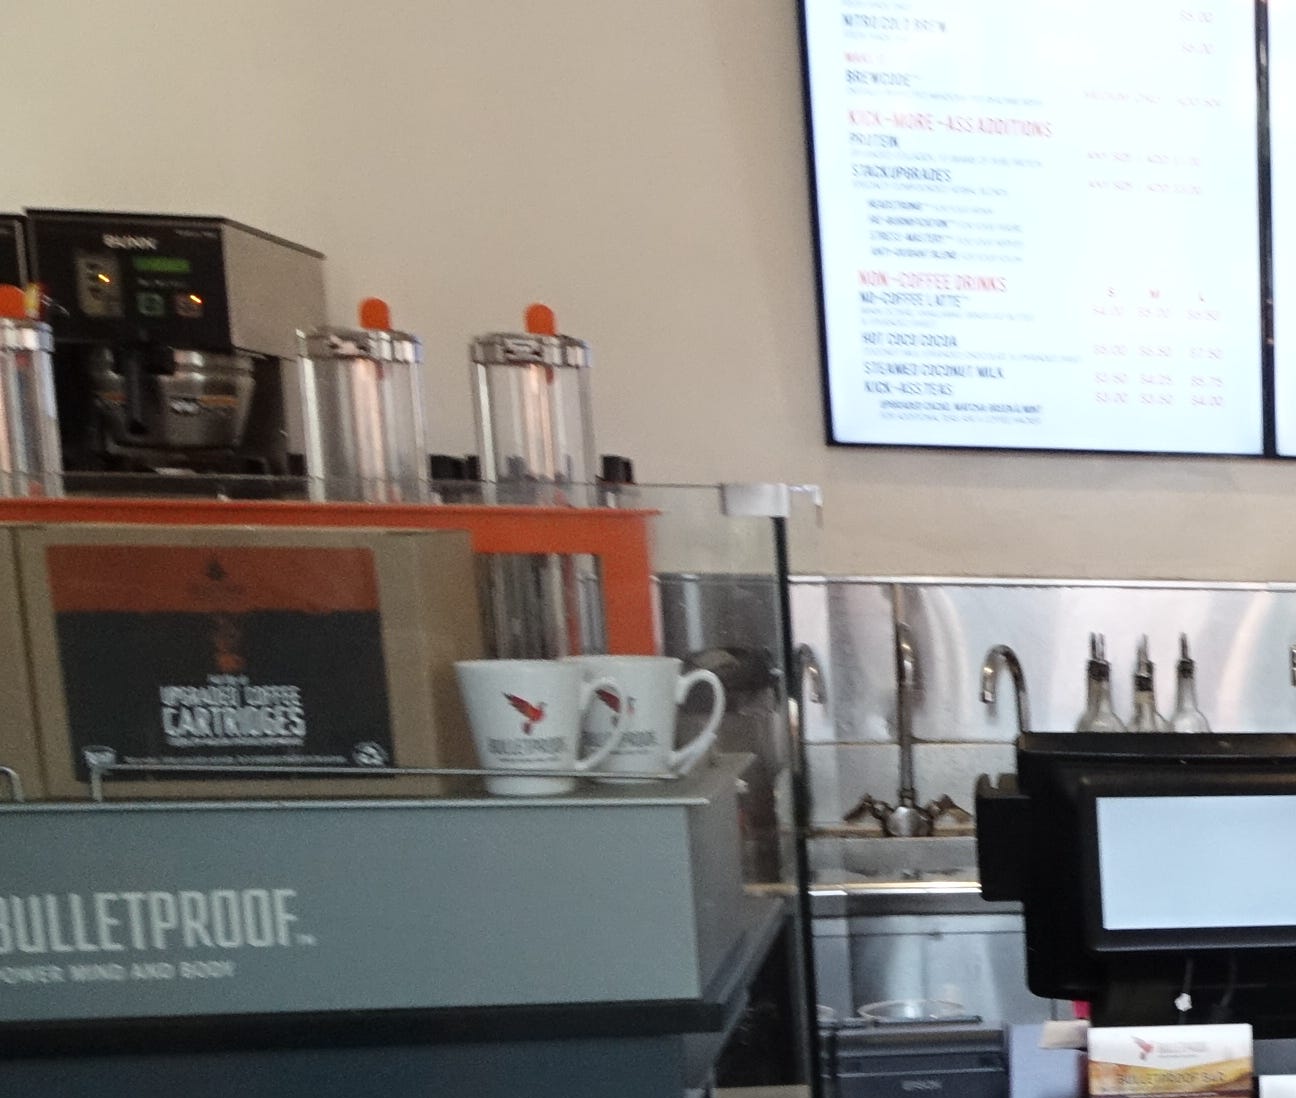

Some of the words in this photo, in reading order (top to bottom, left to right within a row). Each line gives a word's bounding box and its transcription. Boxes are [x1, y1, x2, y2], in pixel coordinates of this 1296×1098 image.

[162, 707, 307, 738] CARTRIDGES
[130, 961, 176, 980] AND
[179, 959, 236, 980] BODY
